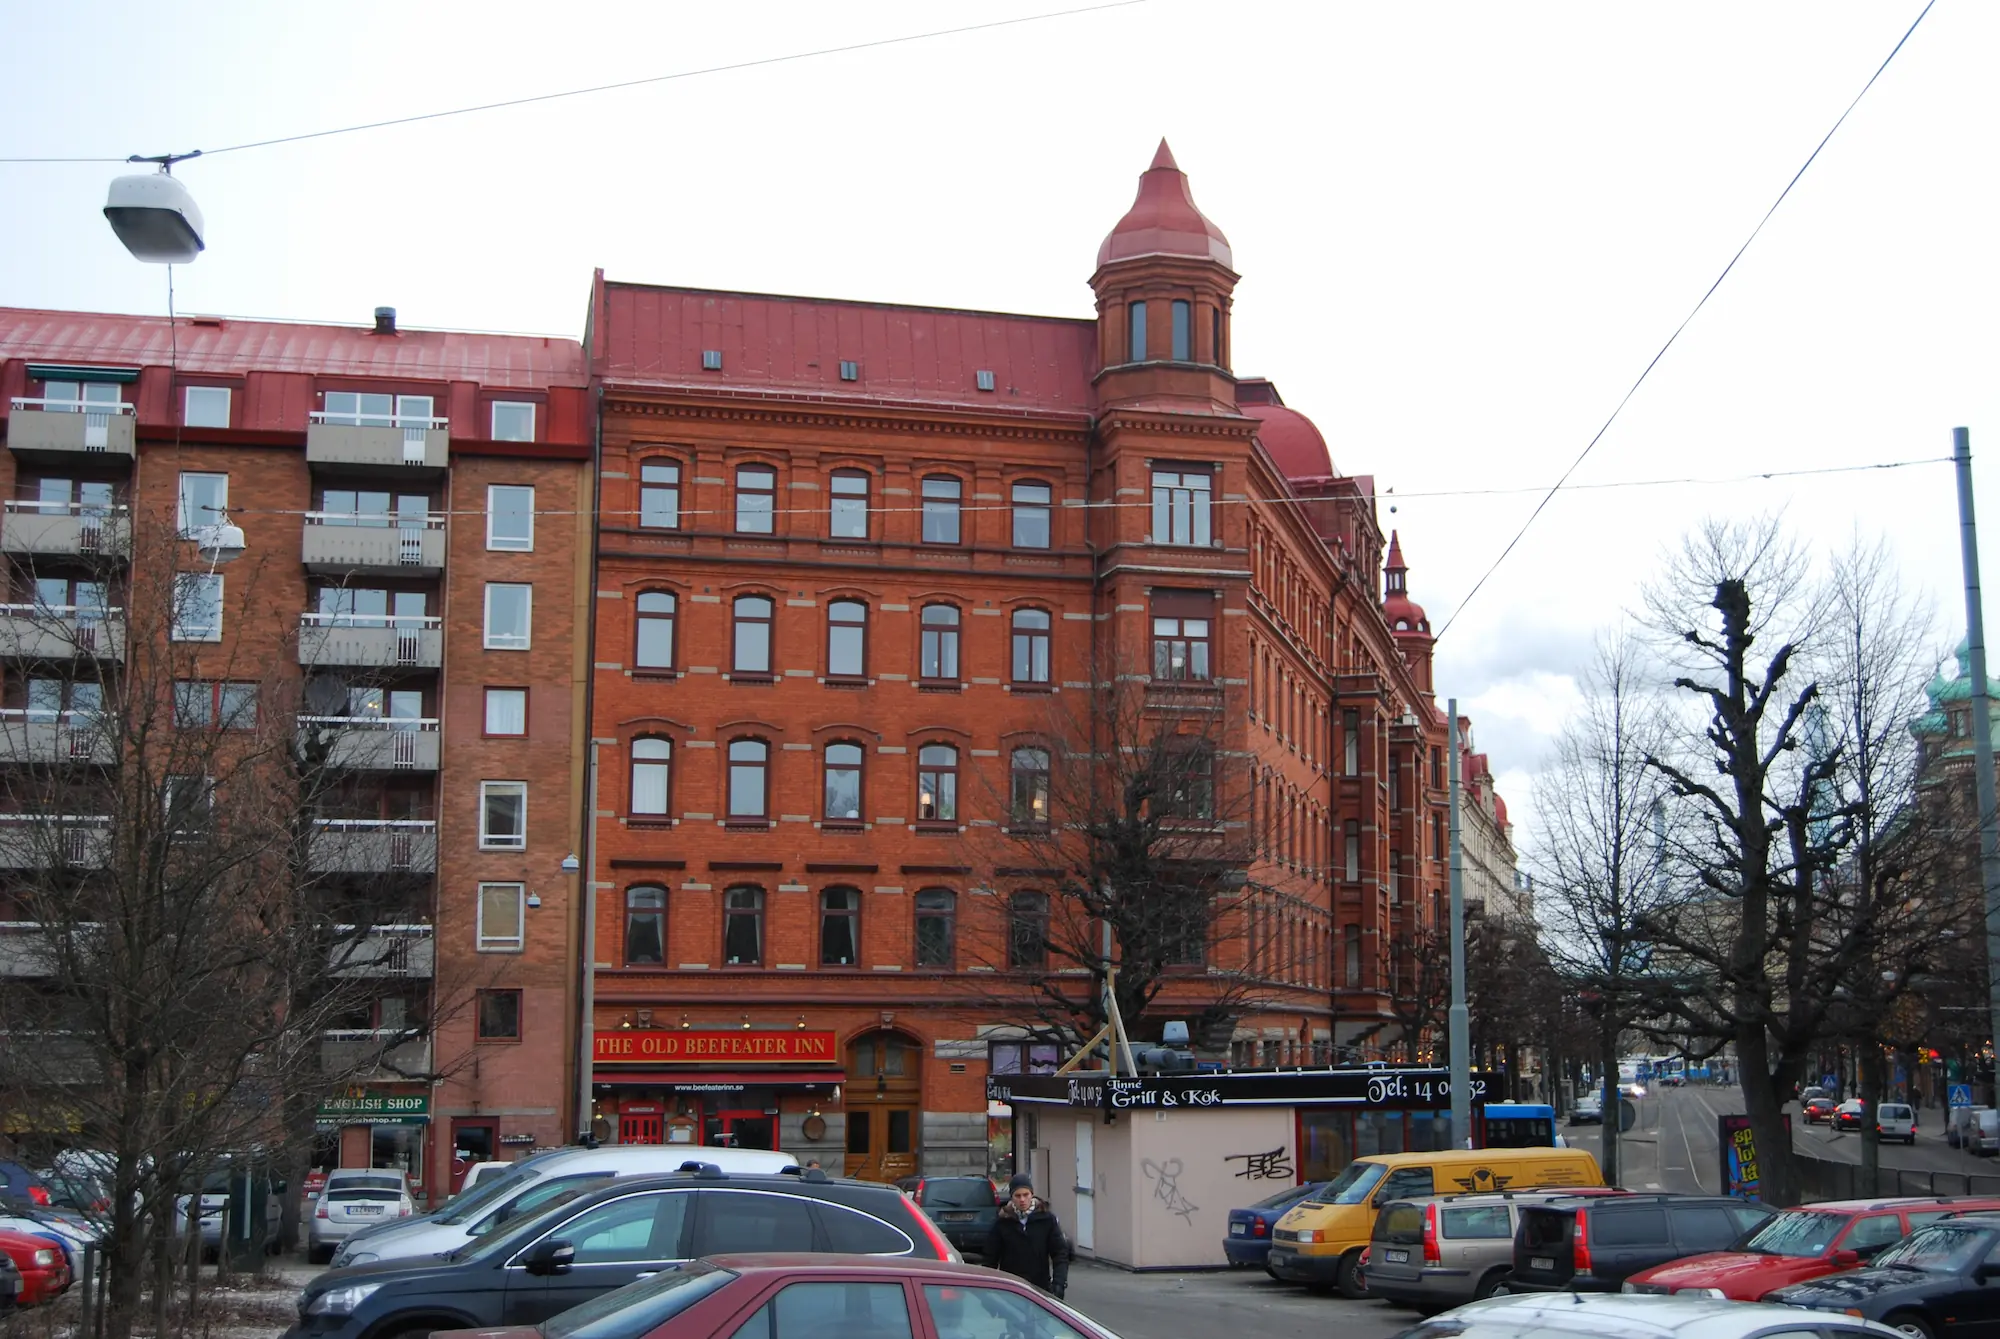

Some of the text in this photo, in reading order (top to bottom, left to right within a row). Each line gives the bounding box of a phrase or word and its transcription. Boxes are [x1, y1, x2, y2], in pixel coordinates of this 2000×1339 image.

[596, 1038, 826, 1054] THE OLD BEEFEATER INN
[674, 1083, 744, 1092] www.beefeaterinn.se
[1106, 1079, 1142, 1093] Linné
[1368, 1076, 1408, 1103] Tel:
[1415, 1081, 1432, 1102] 14
[1438, 1082, 1452, 1096] 0
[323, 1098, 423, 1110] ENGLISH SHOP
[1111, 1089, 1222, 1108] Grill & Kök
